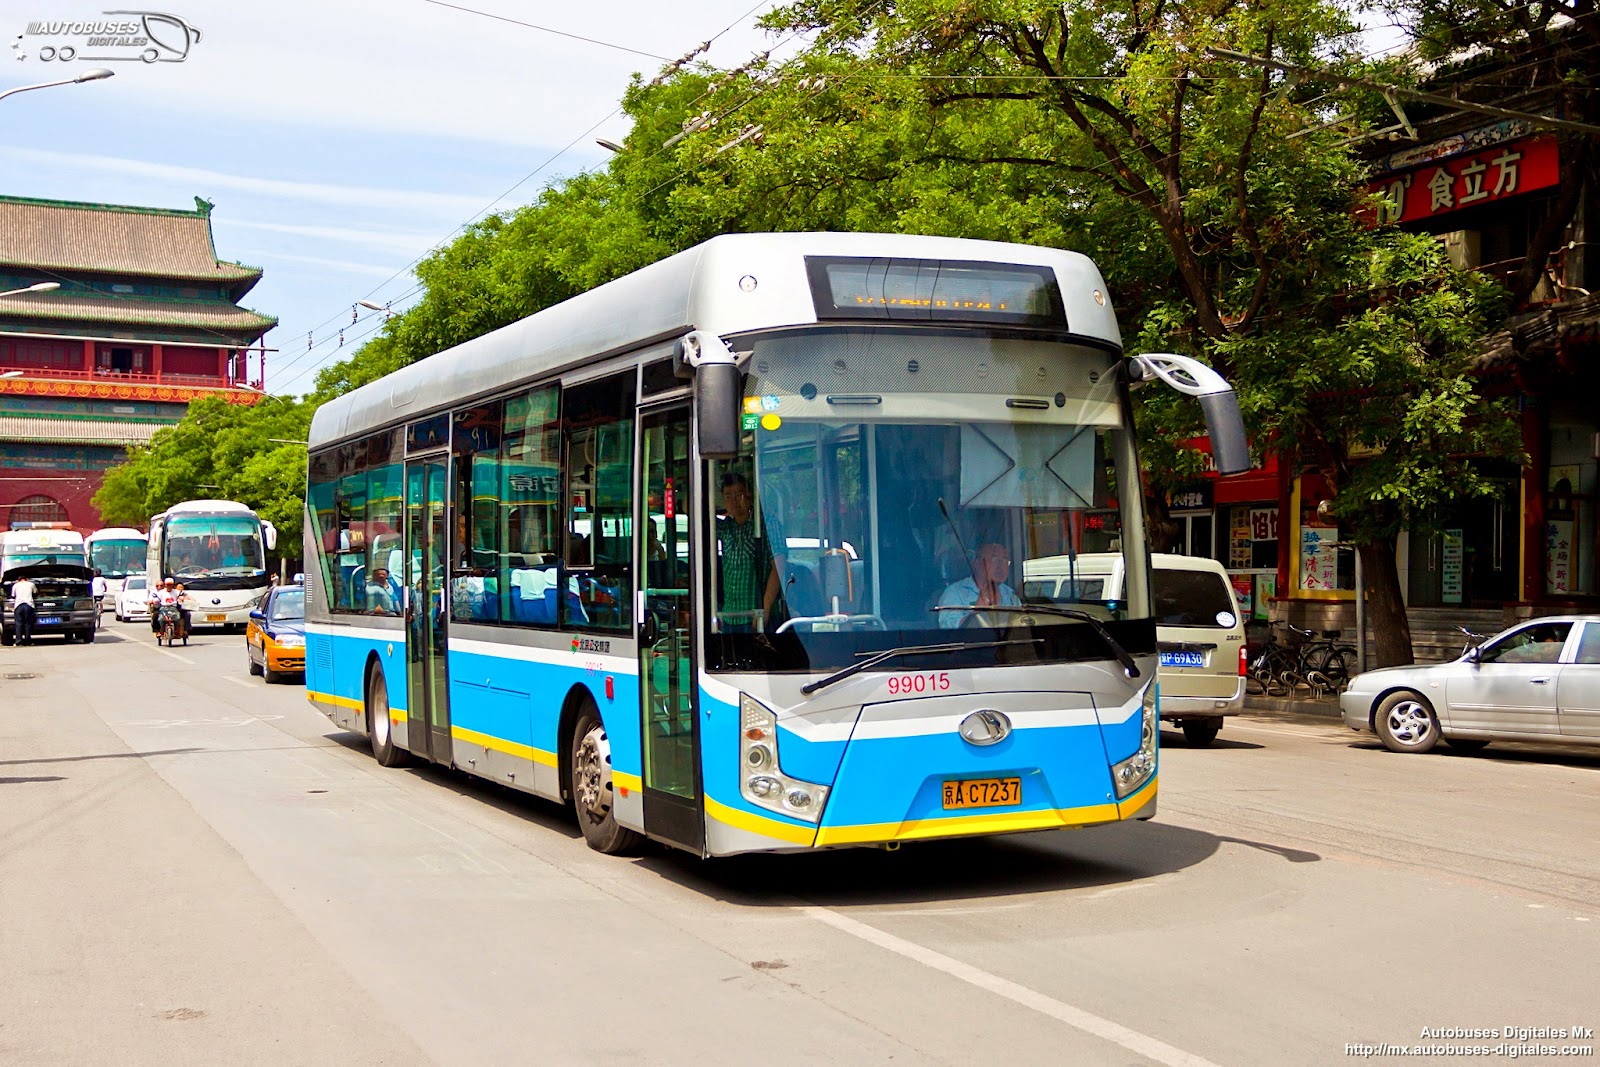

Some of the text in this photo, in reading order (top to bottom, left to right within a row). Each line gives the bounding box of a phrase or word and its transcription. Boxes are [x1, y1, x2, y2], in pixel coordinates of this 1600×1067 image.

[1427, 150, 1521, 212] 食立方
[1303, 531, 1321, 588] 换季清仓
[888, 673, 950, 694] 99015
